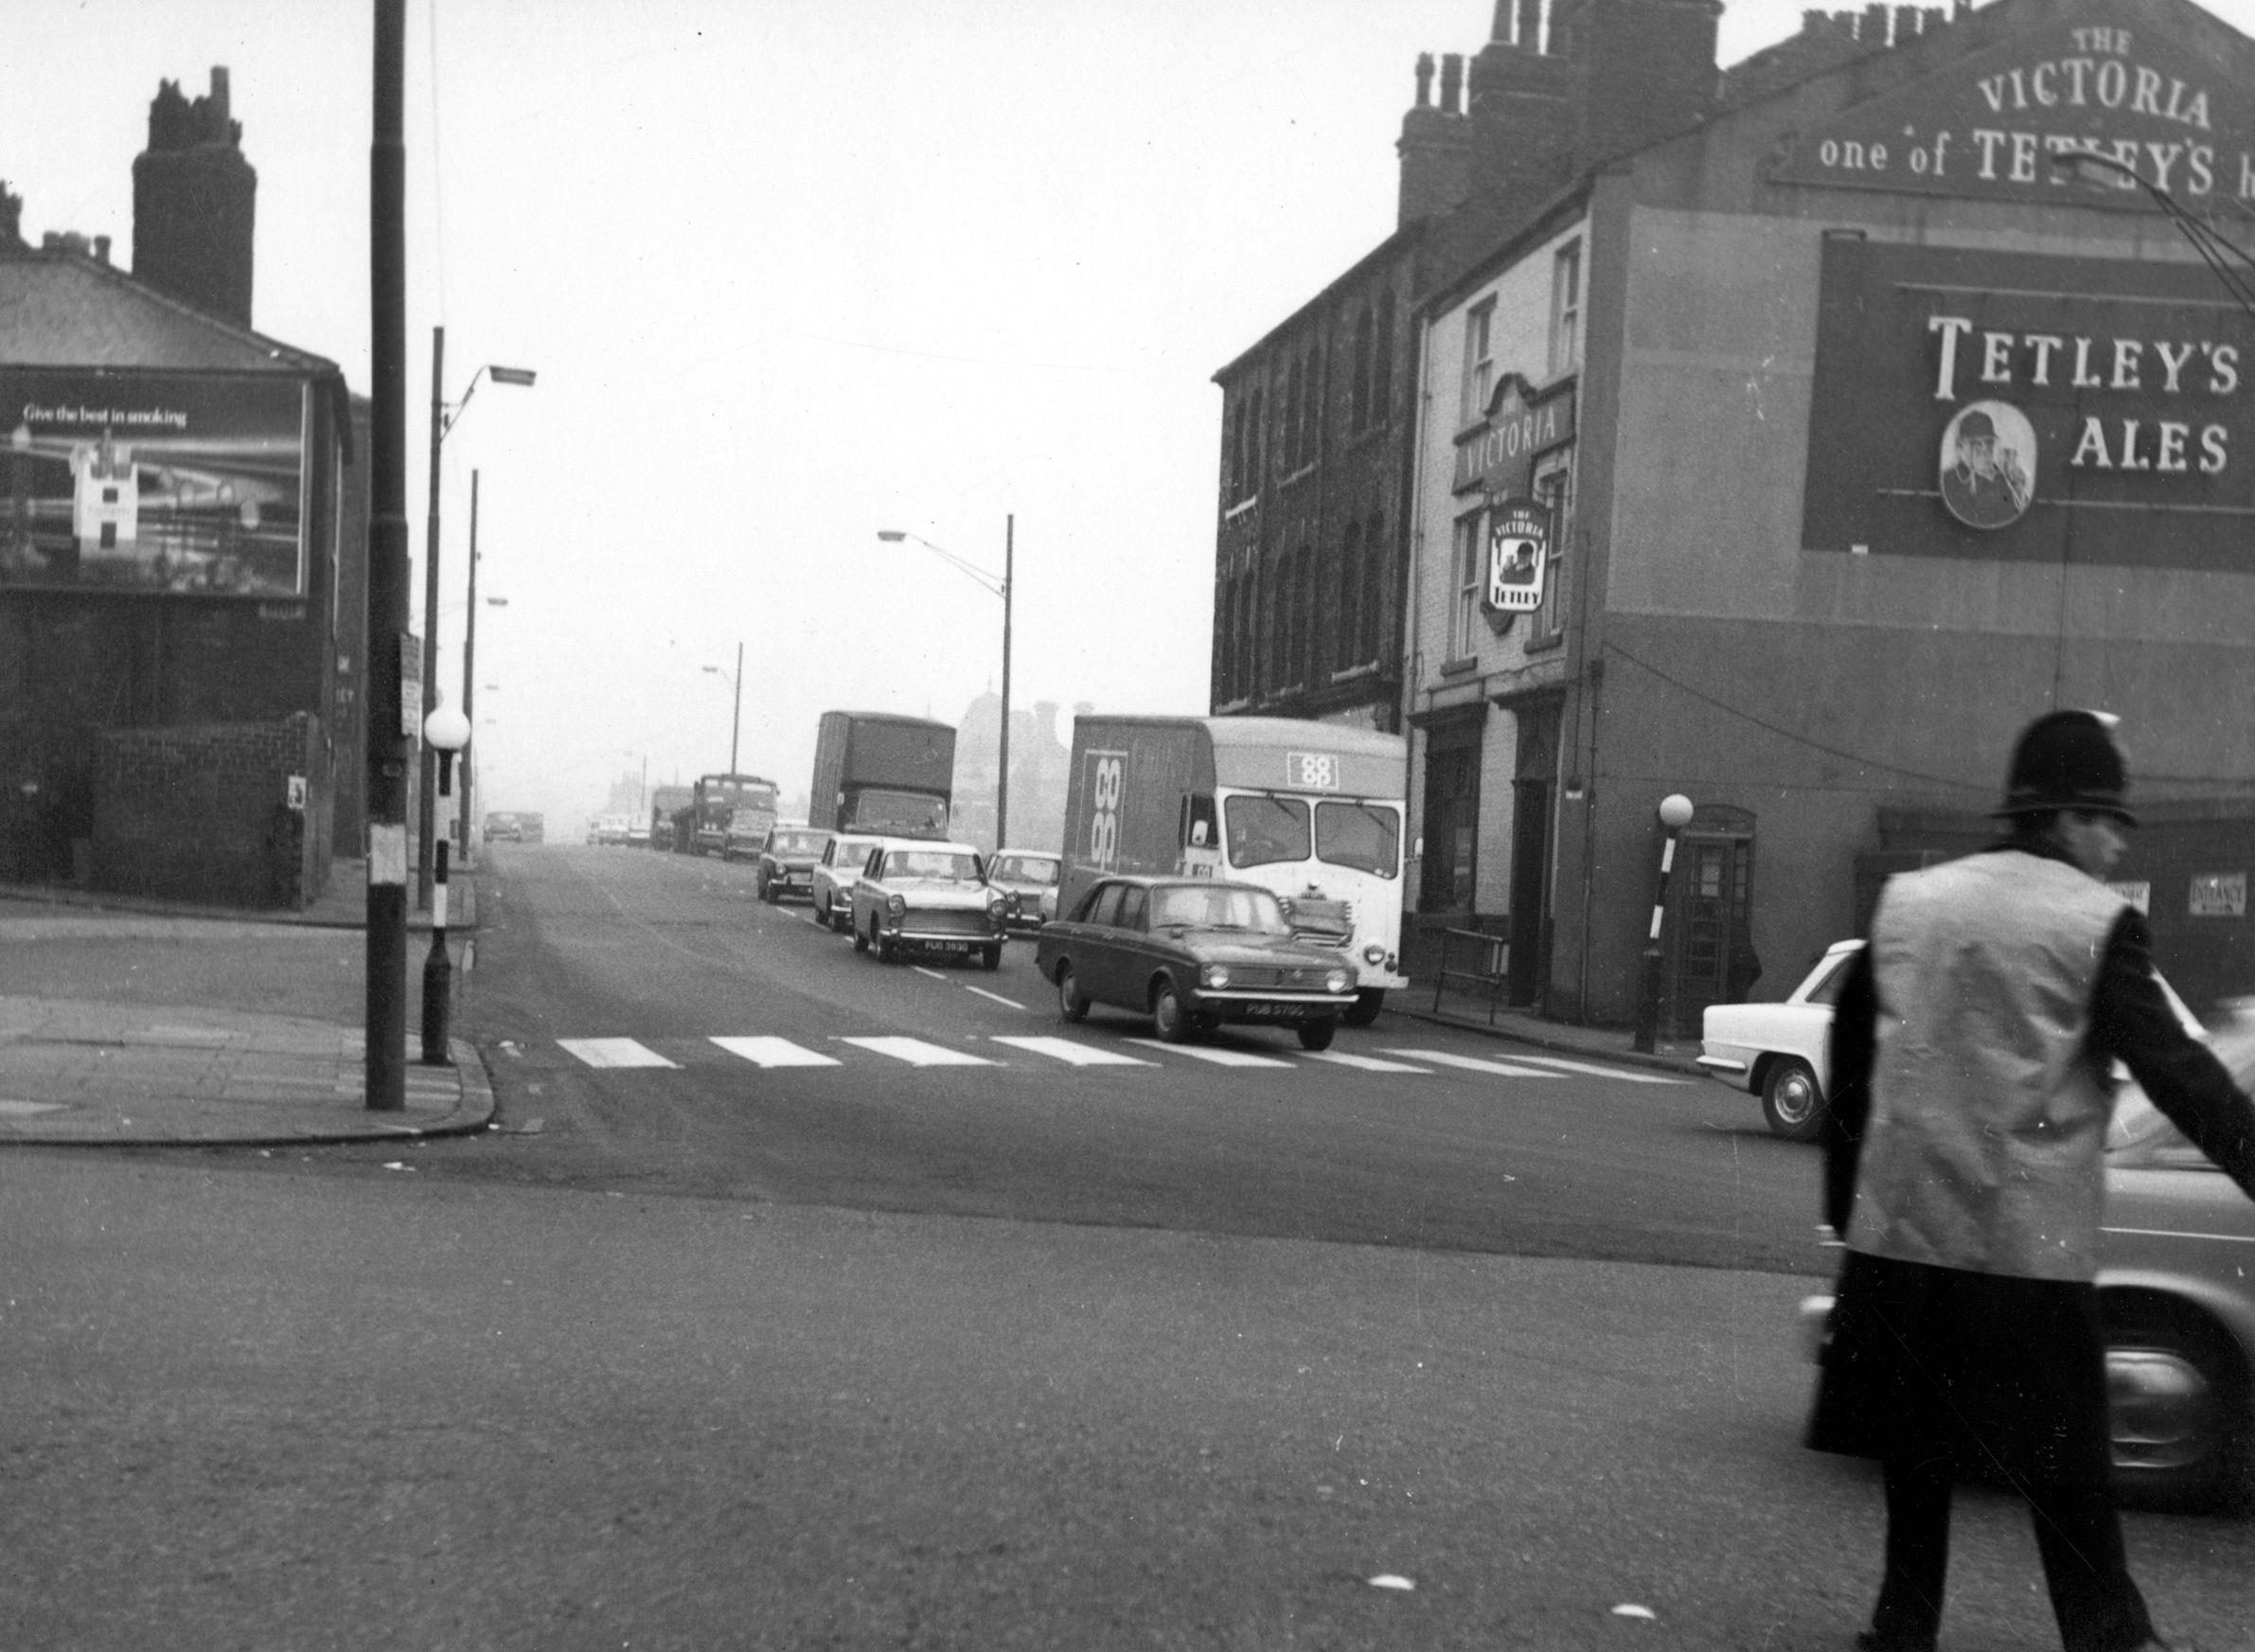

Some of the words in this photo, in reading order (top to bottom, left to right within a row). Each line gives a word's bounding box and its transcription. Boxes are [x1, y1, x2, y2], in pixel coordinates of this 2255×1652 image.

[2071, 27, 2132, 54] THE
[1978, 58, 2211, 130] VICTORIA
[1820, 139, 1889, 170] one
[1909, 132, 1952, 176] of
[1973, 130, 2214, 195] TETEY'S
[1927, 315, 2239, 400] TETLEY'S
[57, 403, 78, 422] the
[80, 405, 108, 424] best
[112, 407, 125, 424] in
[127, 406, 186, 429] smoking
[1466, 405, 1555, 478] VICTORIA
[2070, 416, 2228, 473] ALES
[1496, 520, 1544, 540] VICTORIA
